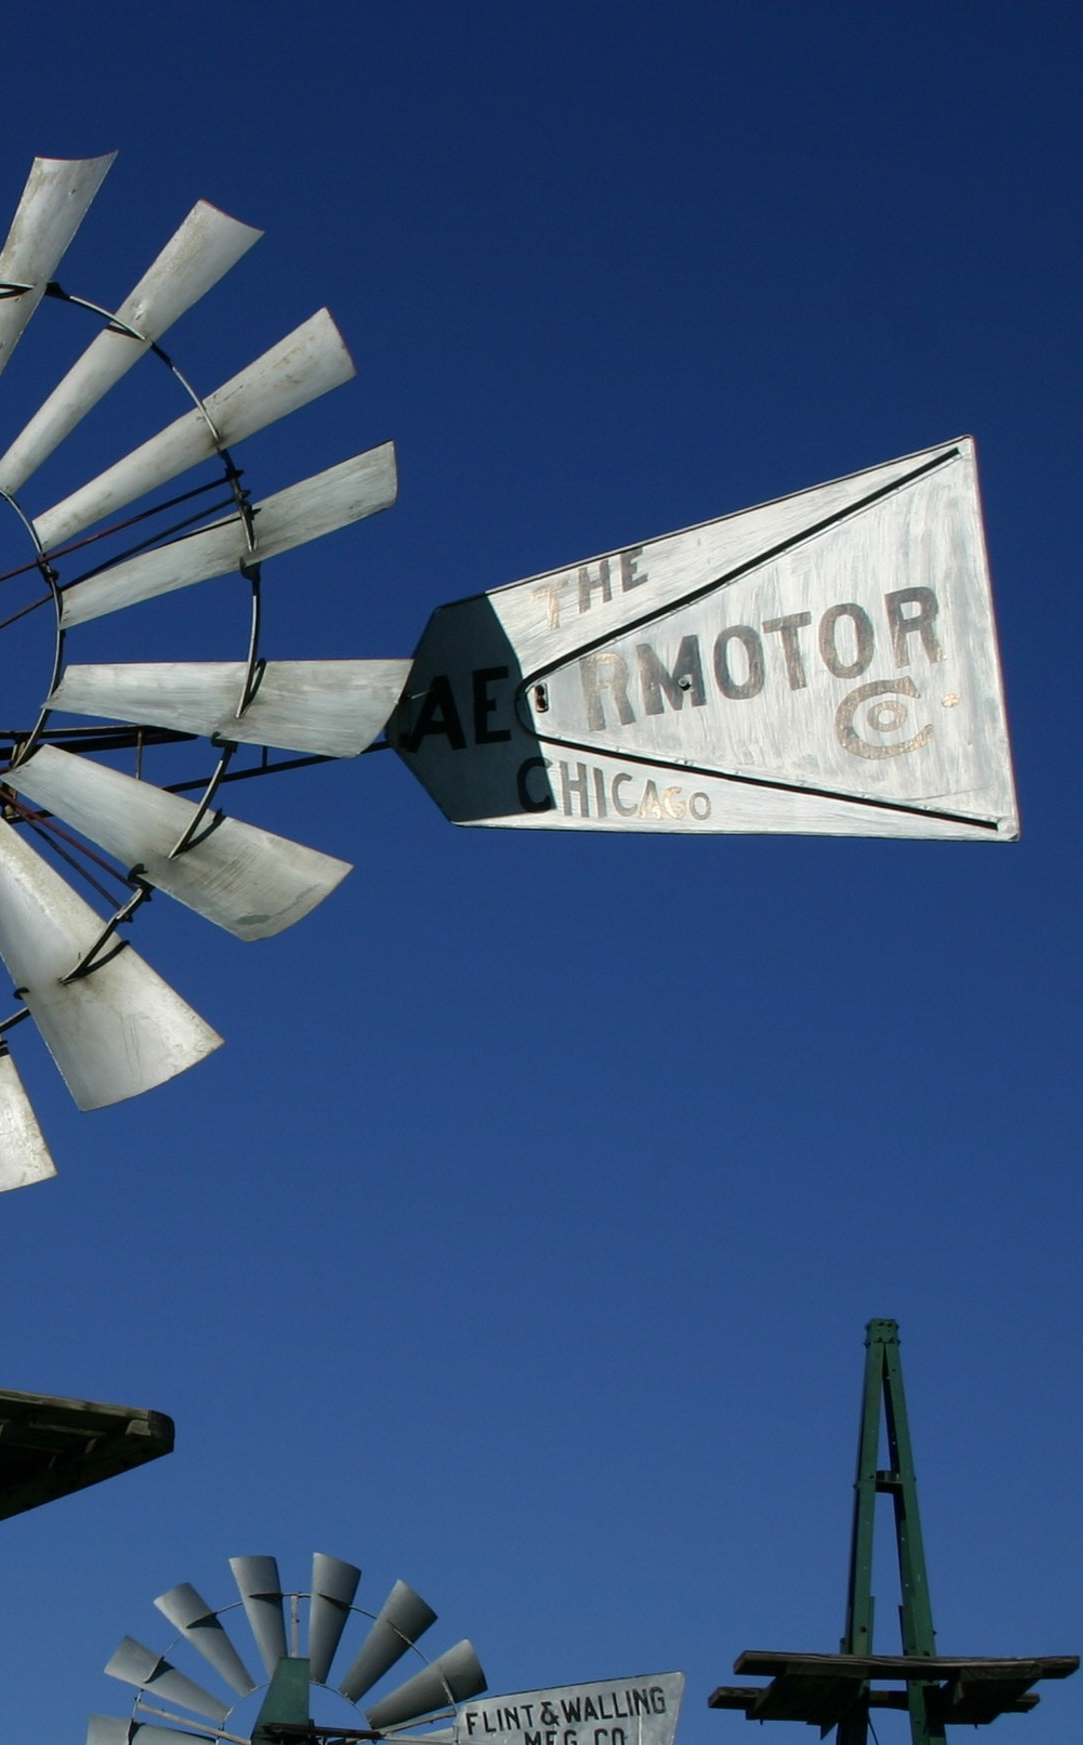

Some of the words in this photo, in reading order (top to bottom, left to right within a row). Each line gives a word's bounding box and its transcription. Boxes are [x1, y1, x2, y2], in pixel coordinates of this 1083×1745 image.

[530, 545, 650, 630] THE
[516, 756, 713, 822] CHICAGO
[465, 1704, 534, 1736] FLINT
[560, 1686, 666, 1724] WALLING
[524, 1729, 578, 1745] MFG
